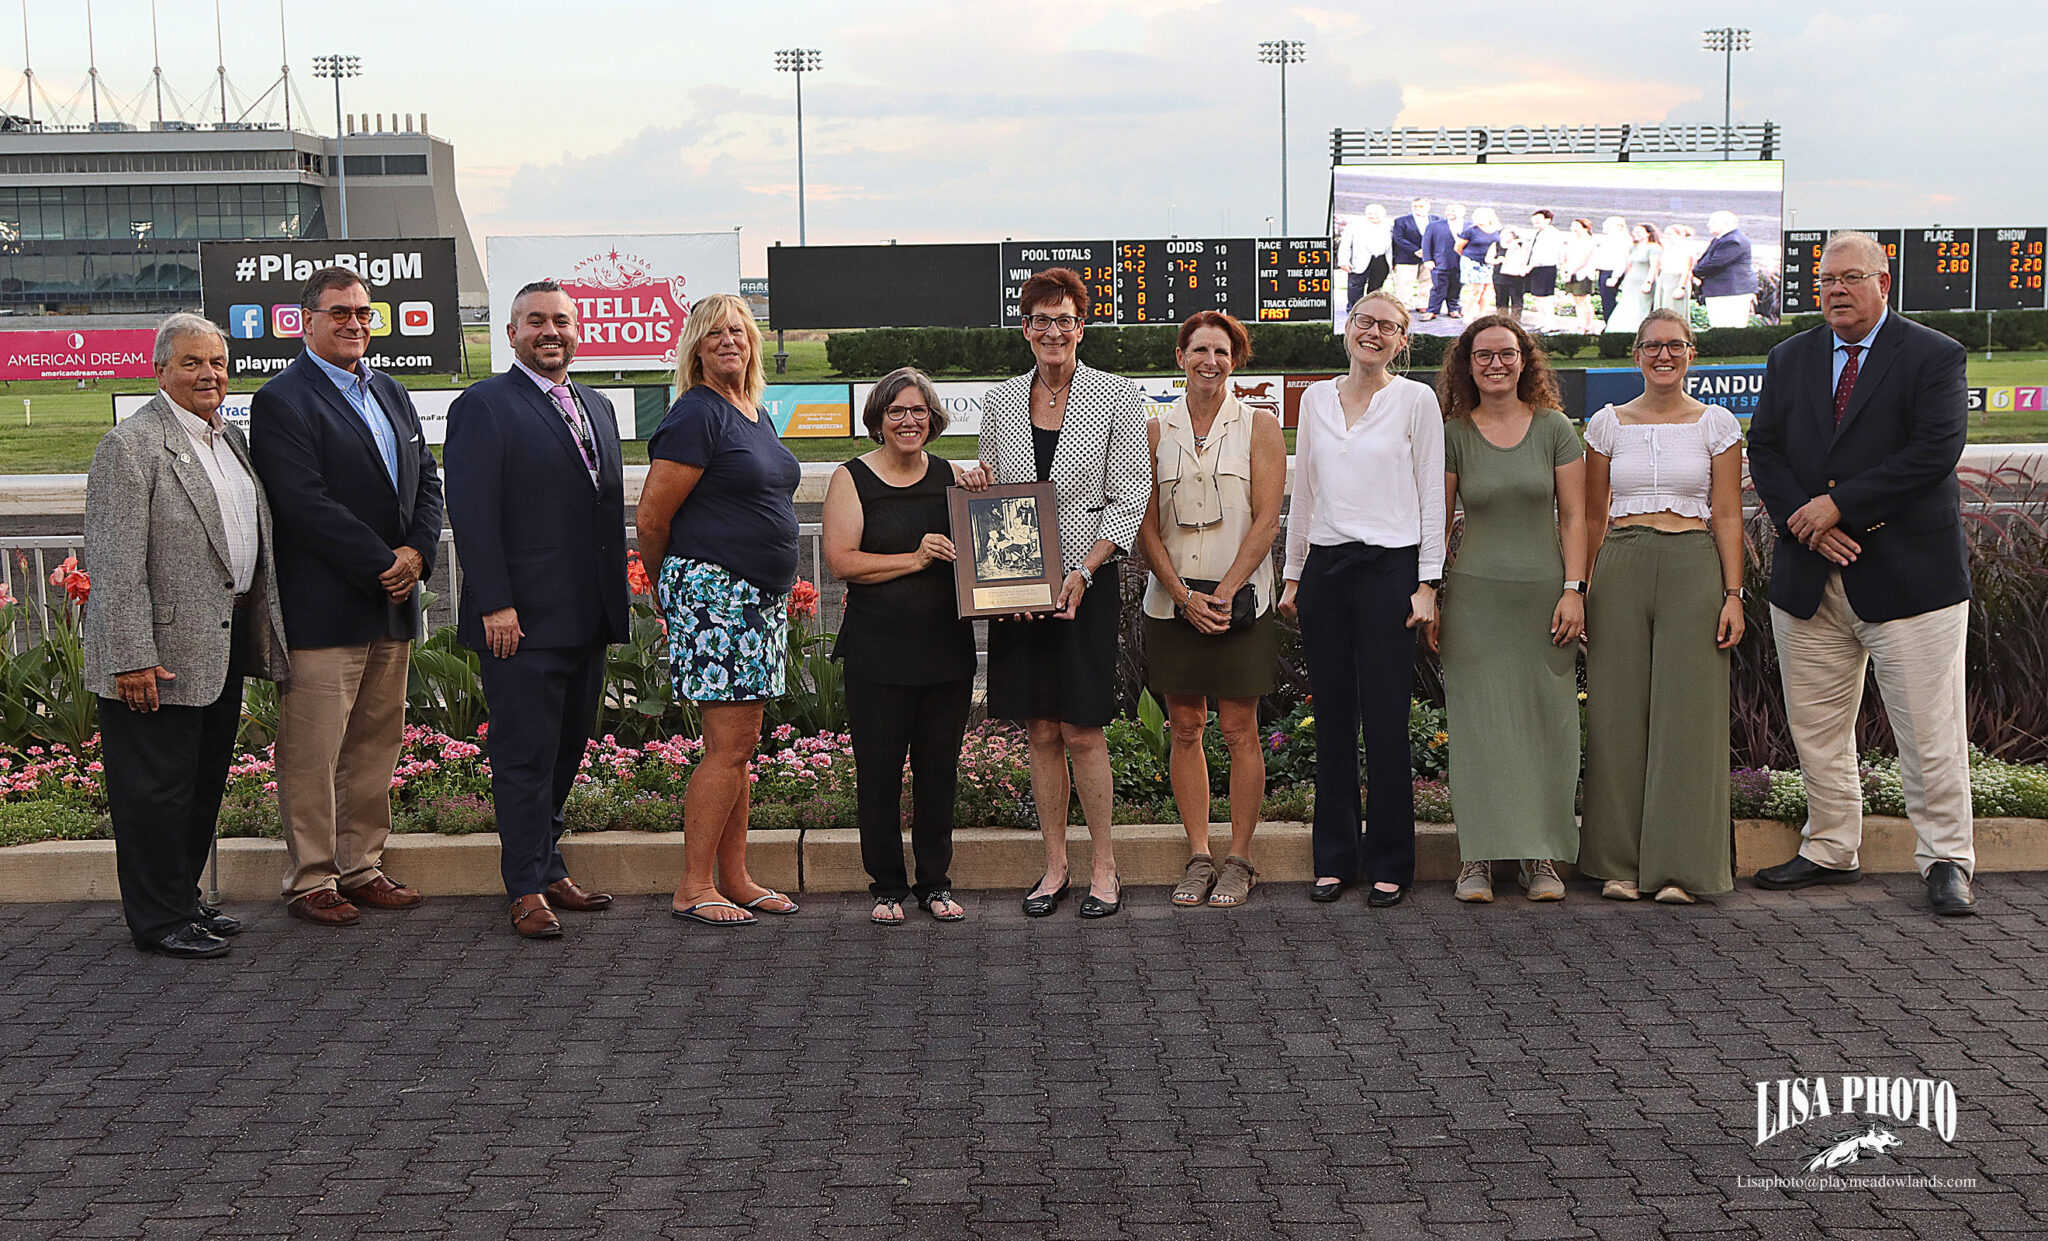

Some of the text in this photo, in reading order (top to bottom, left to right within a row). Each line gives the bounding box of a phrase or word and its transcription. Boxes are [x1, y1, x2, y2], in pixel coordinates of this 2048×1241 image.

[1364, 122, 1750, 157] MEADOWLANDS
[1790, 232, 1822, 242] RESULTS
[1923, 230, 1955, 242] PLACE
[1996, 229, 2027, 242] SHOW
[1117, 246, 1123, 257] 1
[1166, 241, 1204, 254] ODDS
[1214, 244, 1228, 256] 10
[1258, 241, 1282, 250] RACE
[1290, 240, 1328, 250] POST TIME
[1787, 247, 1799, 256] 1st
[1812, 244, 1822, 259] 6
[1936, 242, 1970, 257] 2.20
[2009, 241, 2043, 256] 2.10
[1021, 248, 1092, 262] POOL TOTALS
[1269, 251, 1279, 265] 3
[1297, 250, 1331, 264] 6:57
[573, 253, 652, 272] ANNO 1366
[1117, 262, 1123, 273] 2
[1167, 261, 1174, 272] 6
[1215, 260, 1228, 271] 11
[1785, 263, 1800, 273] 2nd
[1936, 259, 1970, 274] 2.80
[2009, 258, 2043, 273] 2.20
[235, 252, 423, 287] #PlayBigM
[1009, 268, 1032, 281] WIN
[1260, 269, 1279, 278] MTP
[1286, 269, 1328, 278] TIME OF DAY
[1117, 278, 1123, 289] 3
[1137, 275, 1146, 290] 5
[1167, 277, 1174, 288] 7
[1188, 275, 1198, 289] 8
[1214, 276, 1228, 287] 12
[1269, 279, 1279, 292] 7
[1297, 279, 1331, 292] 6:50
[1786, 281, 1799, 290] 3rd
[2008, 274, 2042, 290] 2.10
[1005, 286, 1023, 299] PLA
[1094, 284, 1113, 298] 79
[1214, 292, 1228, 303] 13
[1117, 293, 1123, 304] 4
[1137, 291, 1146, 306] 8
[1167, 292, 1174, 304] 8
[1263, 298, 1327, 309] TRACK CONDITION
[1786, 297, 1799, 307] 4th
[571, 296, 670, 319] TELLA
[1006, 304, 1020, 317] SH
[1093, 302, 1114, 317] 20
[1137, 307, 1146, 321] 6
[1168, 308, 1175, 320] 9
[1260, 308, 1291, 320] FAST
[1117, 309, 1124, 320] 5
[7, 352, 147, 367] AMERICAN DREAM.
[41, 369, 115, 378] americandream.com
[1286, 380, 1316, 389] BREED
[1687, 375, 1763, 395] FANDU
[1698, 396, 1760, 407] PORTSB
[1967, 389, 2037, 409] 5 6 7
[219, 404, 252, 417] Trac
